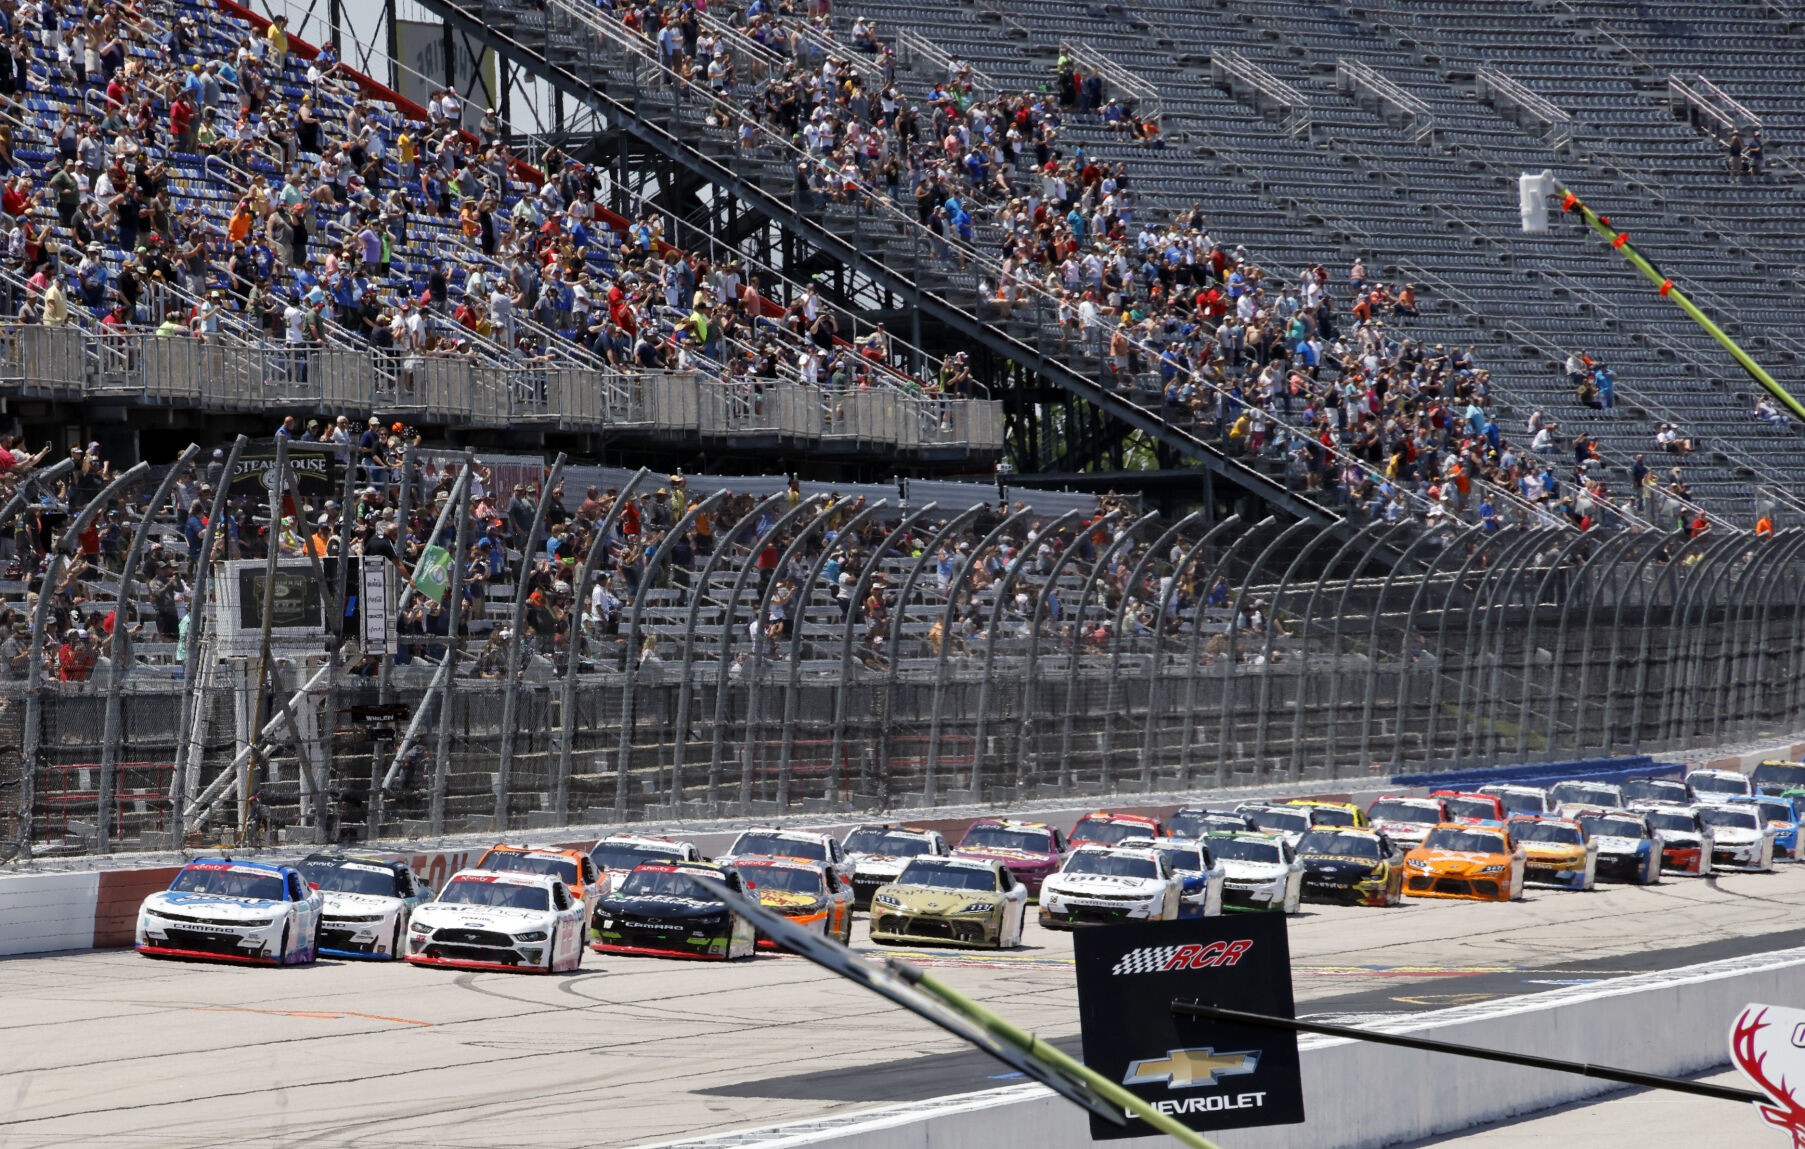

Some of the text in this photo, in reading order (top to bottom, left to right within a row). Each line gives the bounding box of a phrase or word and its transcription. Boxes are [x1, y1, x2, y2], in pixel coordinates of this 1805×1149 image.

[234, 458, 327, 475] STEAKOUSE
[173, 923, 234, 933] CAMARO
[1164, 939, 1254, 971] RCR
